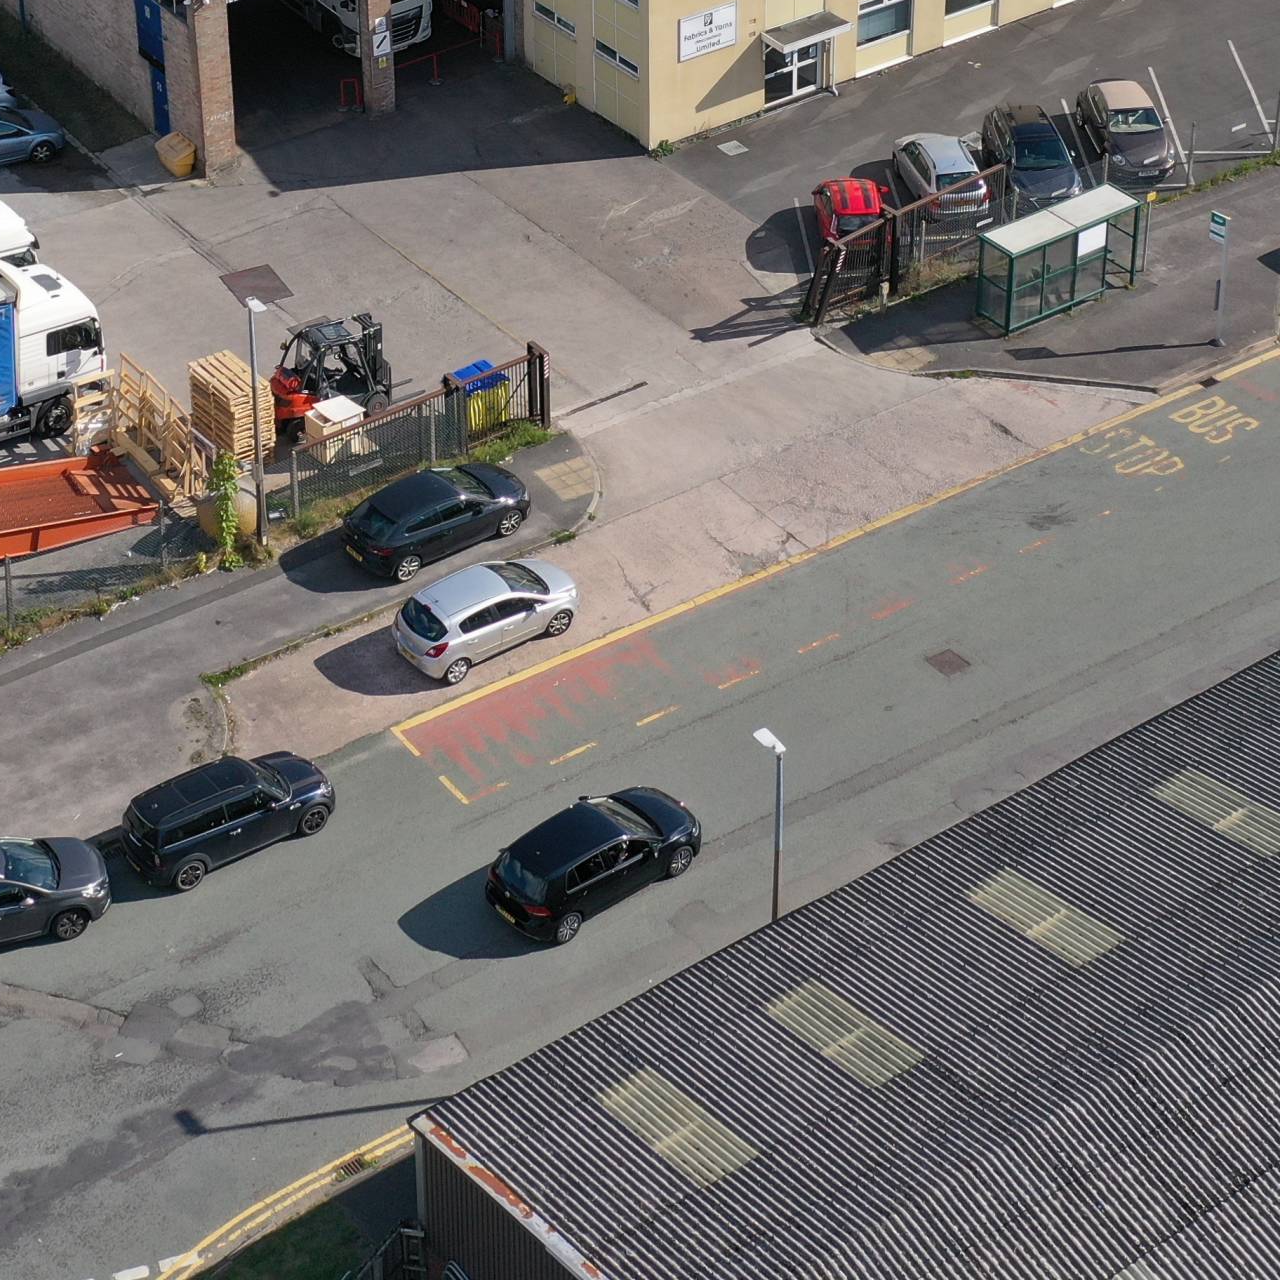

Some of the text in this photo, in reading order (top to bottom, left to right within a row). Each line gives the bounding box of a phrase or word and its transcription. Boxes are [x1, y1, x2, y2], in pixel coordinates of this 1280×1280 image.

[683, 30, 708, 42] Fabrics
[714, 21, 733, 31] Yarns
[696, 39, 721, 52] Limited
[1168, 396, 1260, 444] BUS
[1079, 427, 1184, 476] STOP
